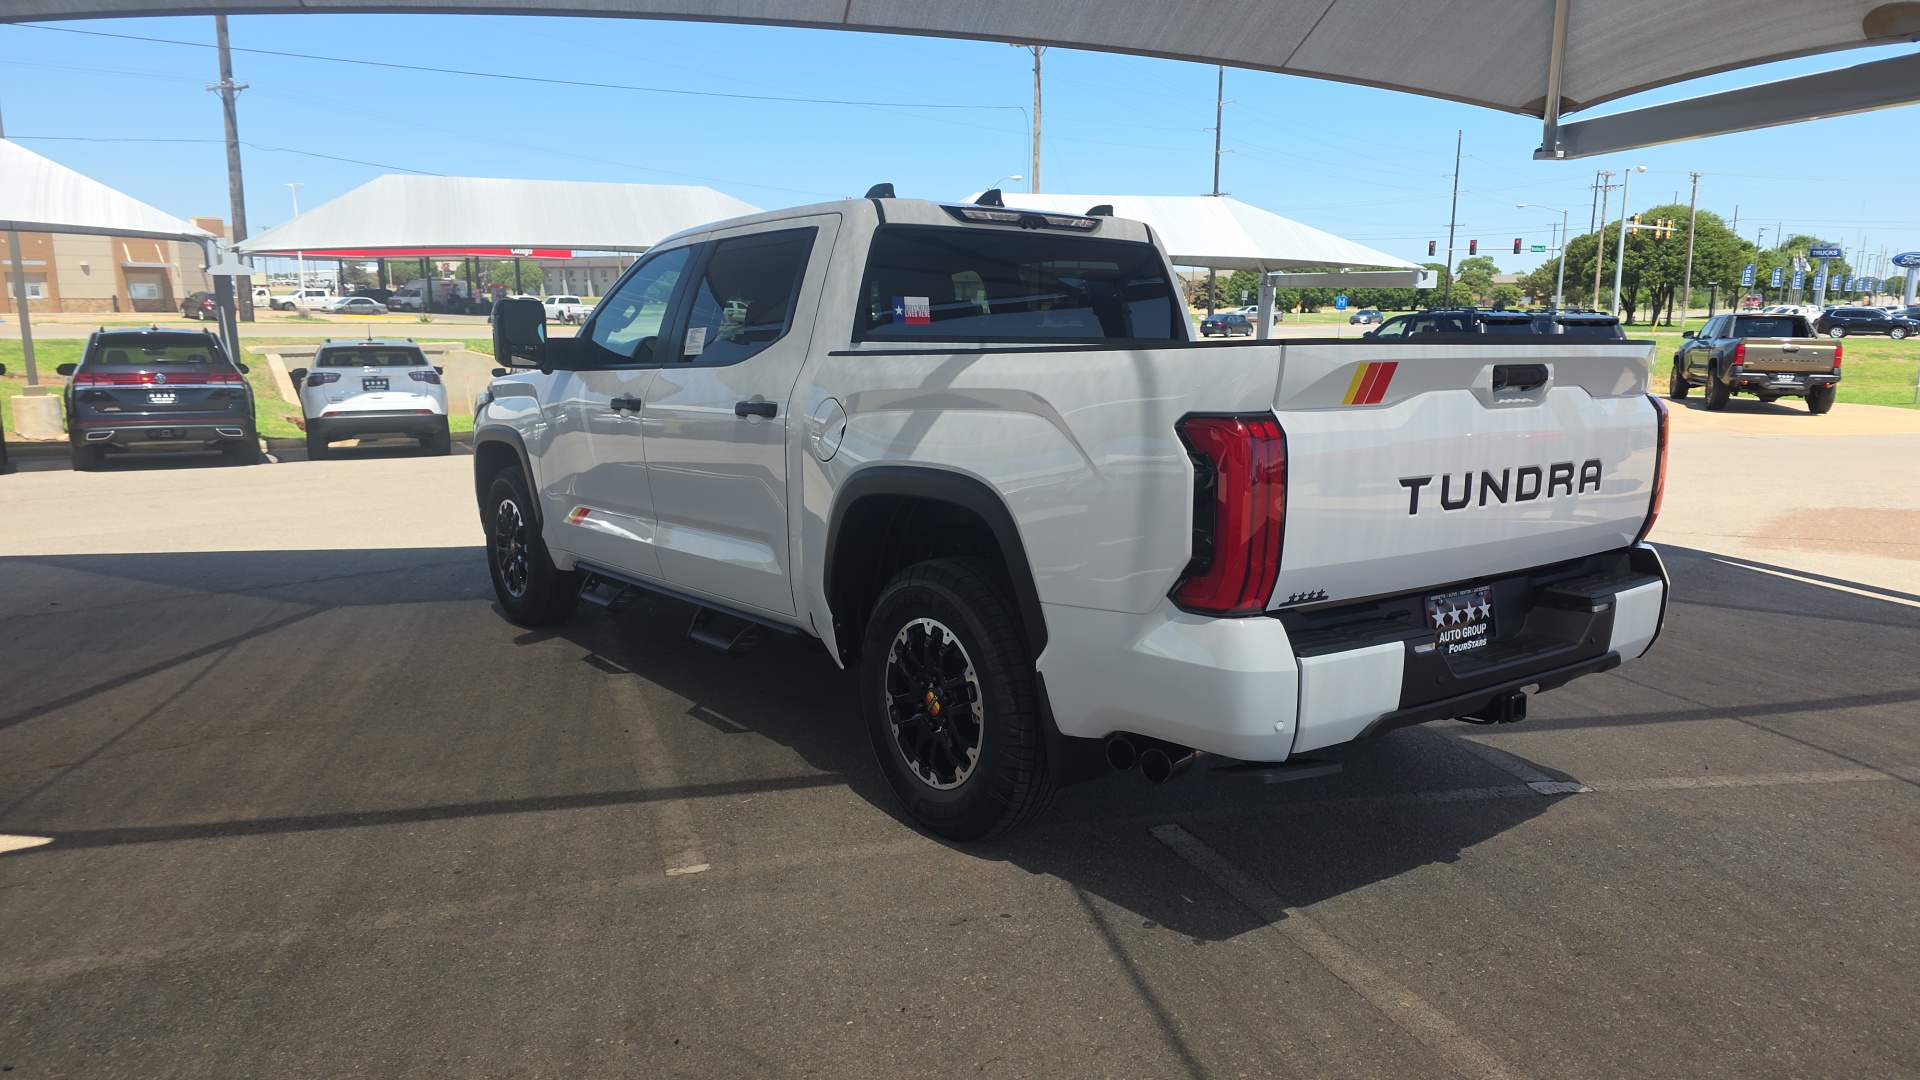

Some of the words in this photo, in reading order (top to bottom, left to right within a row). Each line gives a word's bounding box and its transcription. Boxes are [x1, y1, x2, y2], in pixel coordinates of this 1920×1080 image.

[1338, 297, 1345, 306] H
[1398, 459, 1602, 515] TUNDRA
[1439, 628, 1461, 643] AUTO
[1462, 623, 1486, 638] GROUP
